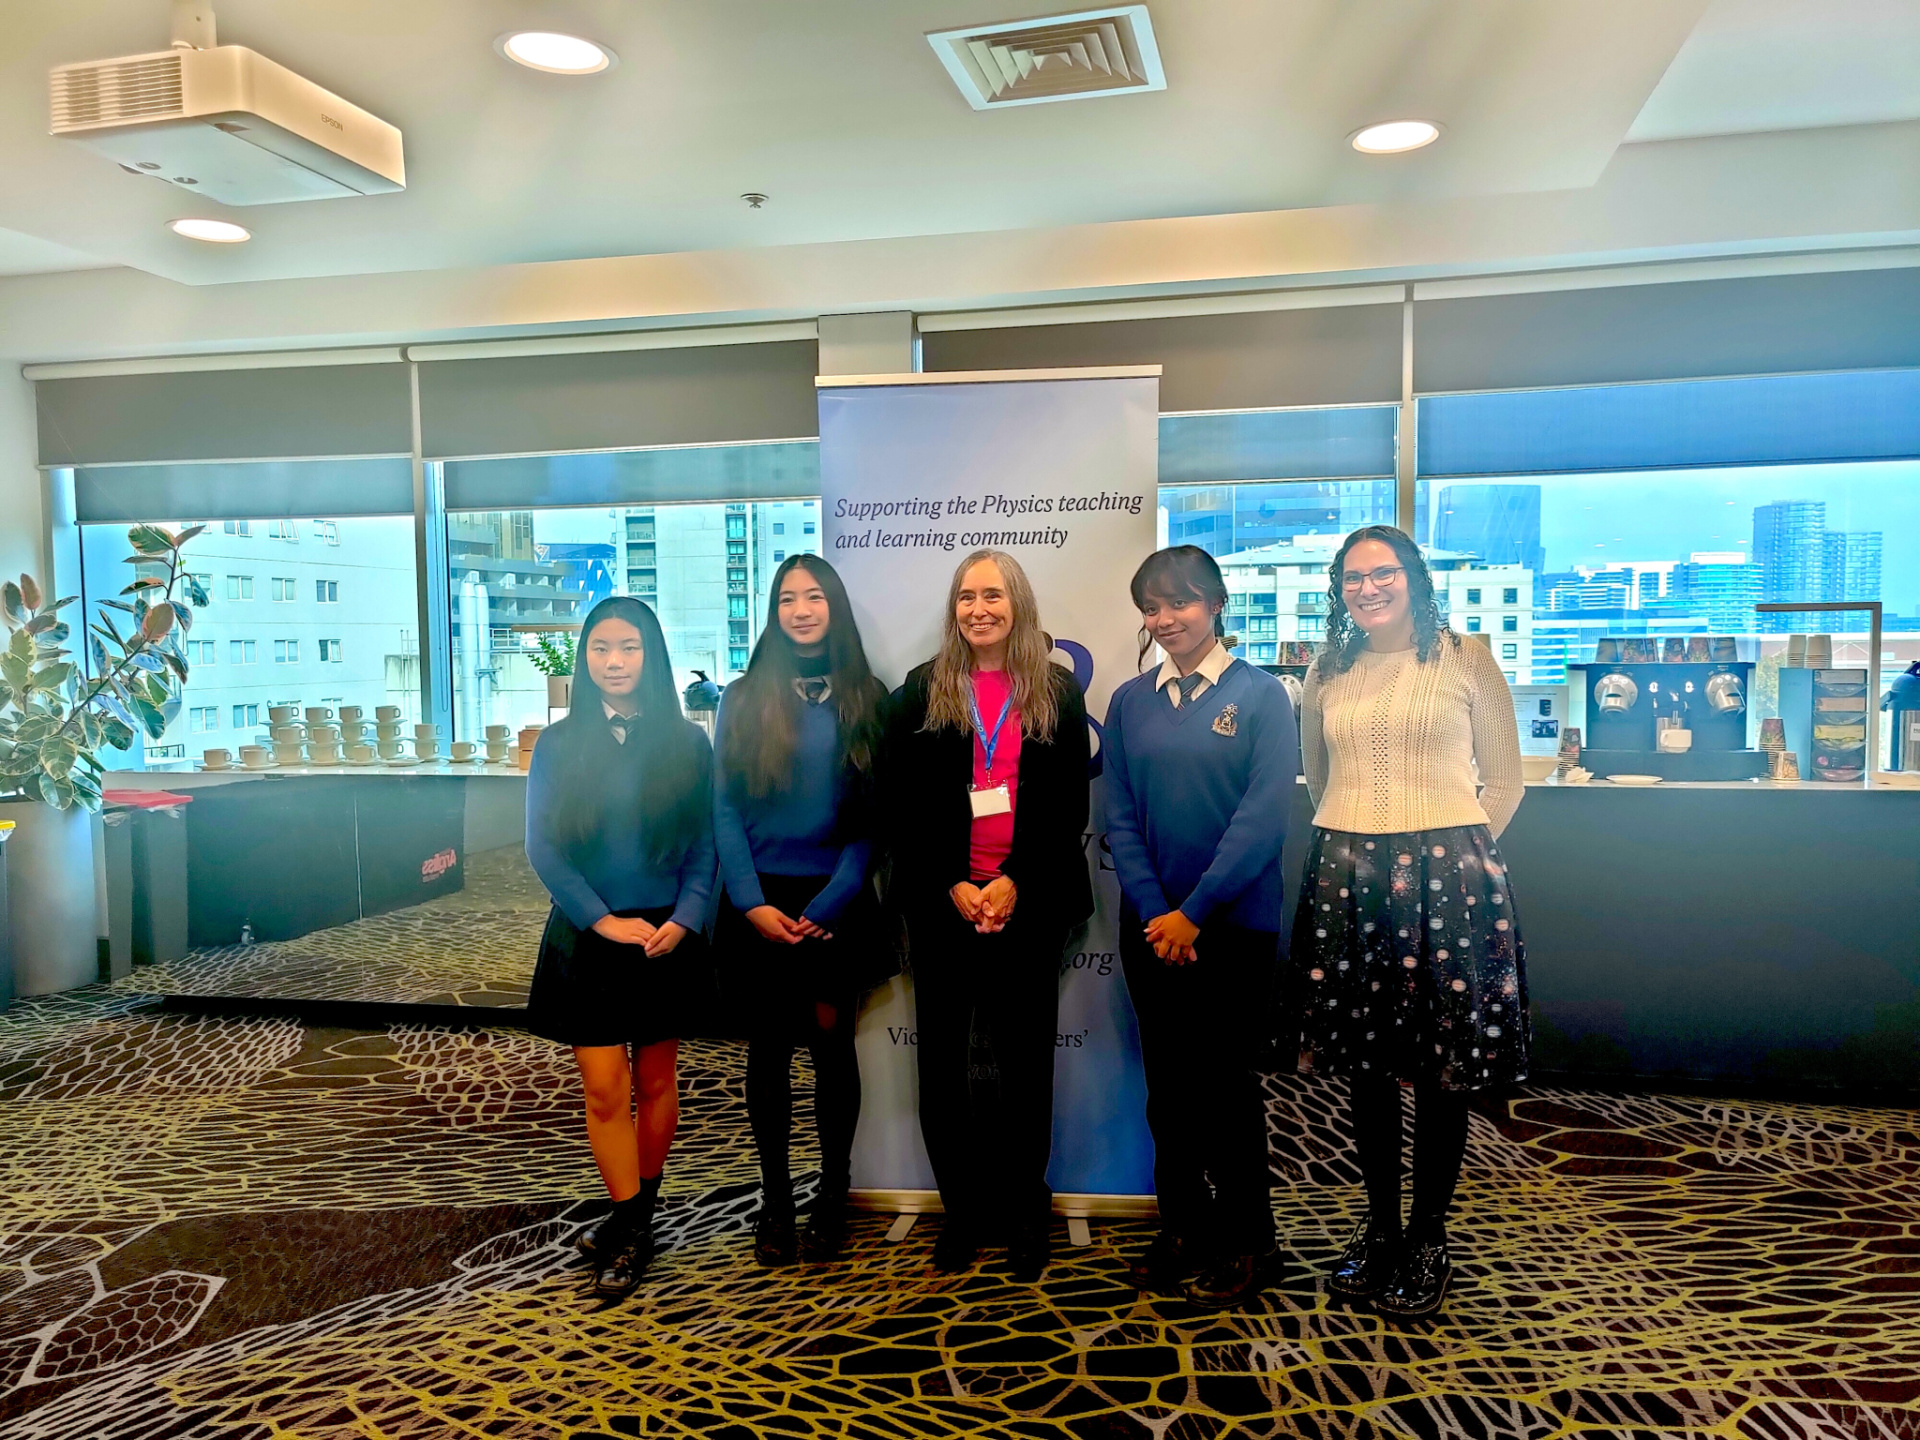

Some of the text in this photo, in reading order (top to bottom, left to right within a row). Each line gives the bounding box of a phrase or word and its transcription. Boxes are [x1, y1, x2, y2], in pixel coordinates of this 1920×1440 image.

[321, 113, 344, 132] EPSON
[834, 491, 1144, 521] Supporting the Physics teaching
[835, 526, 1068, 552] and learning community
